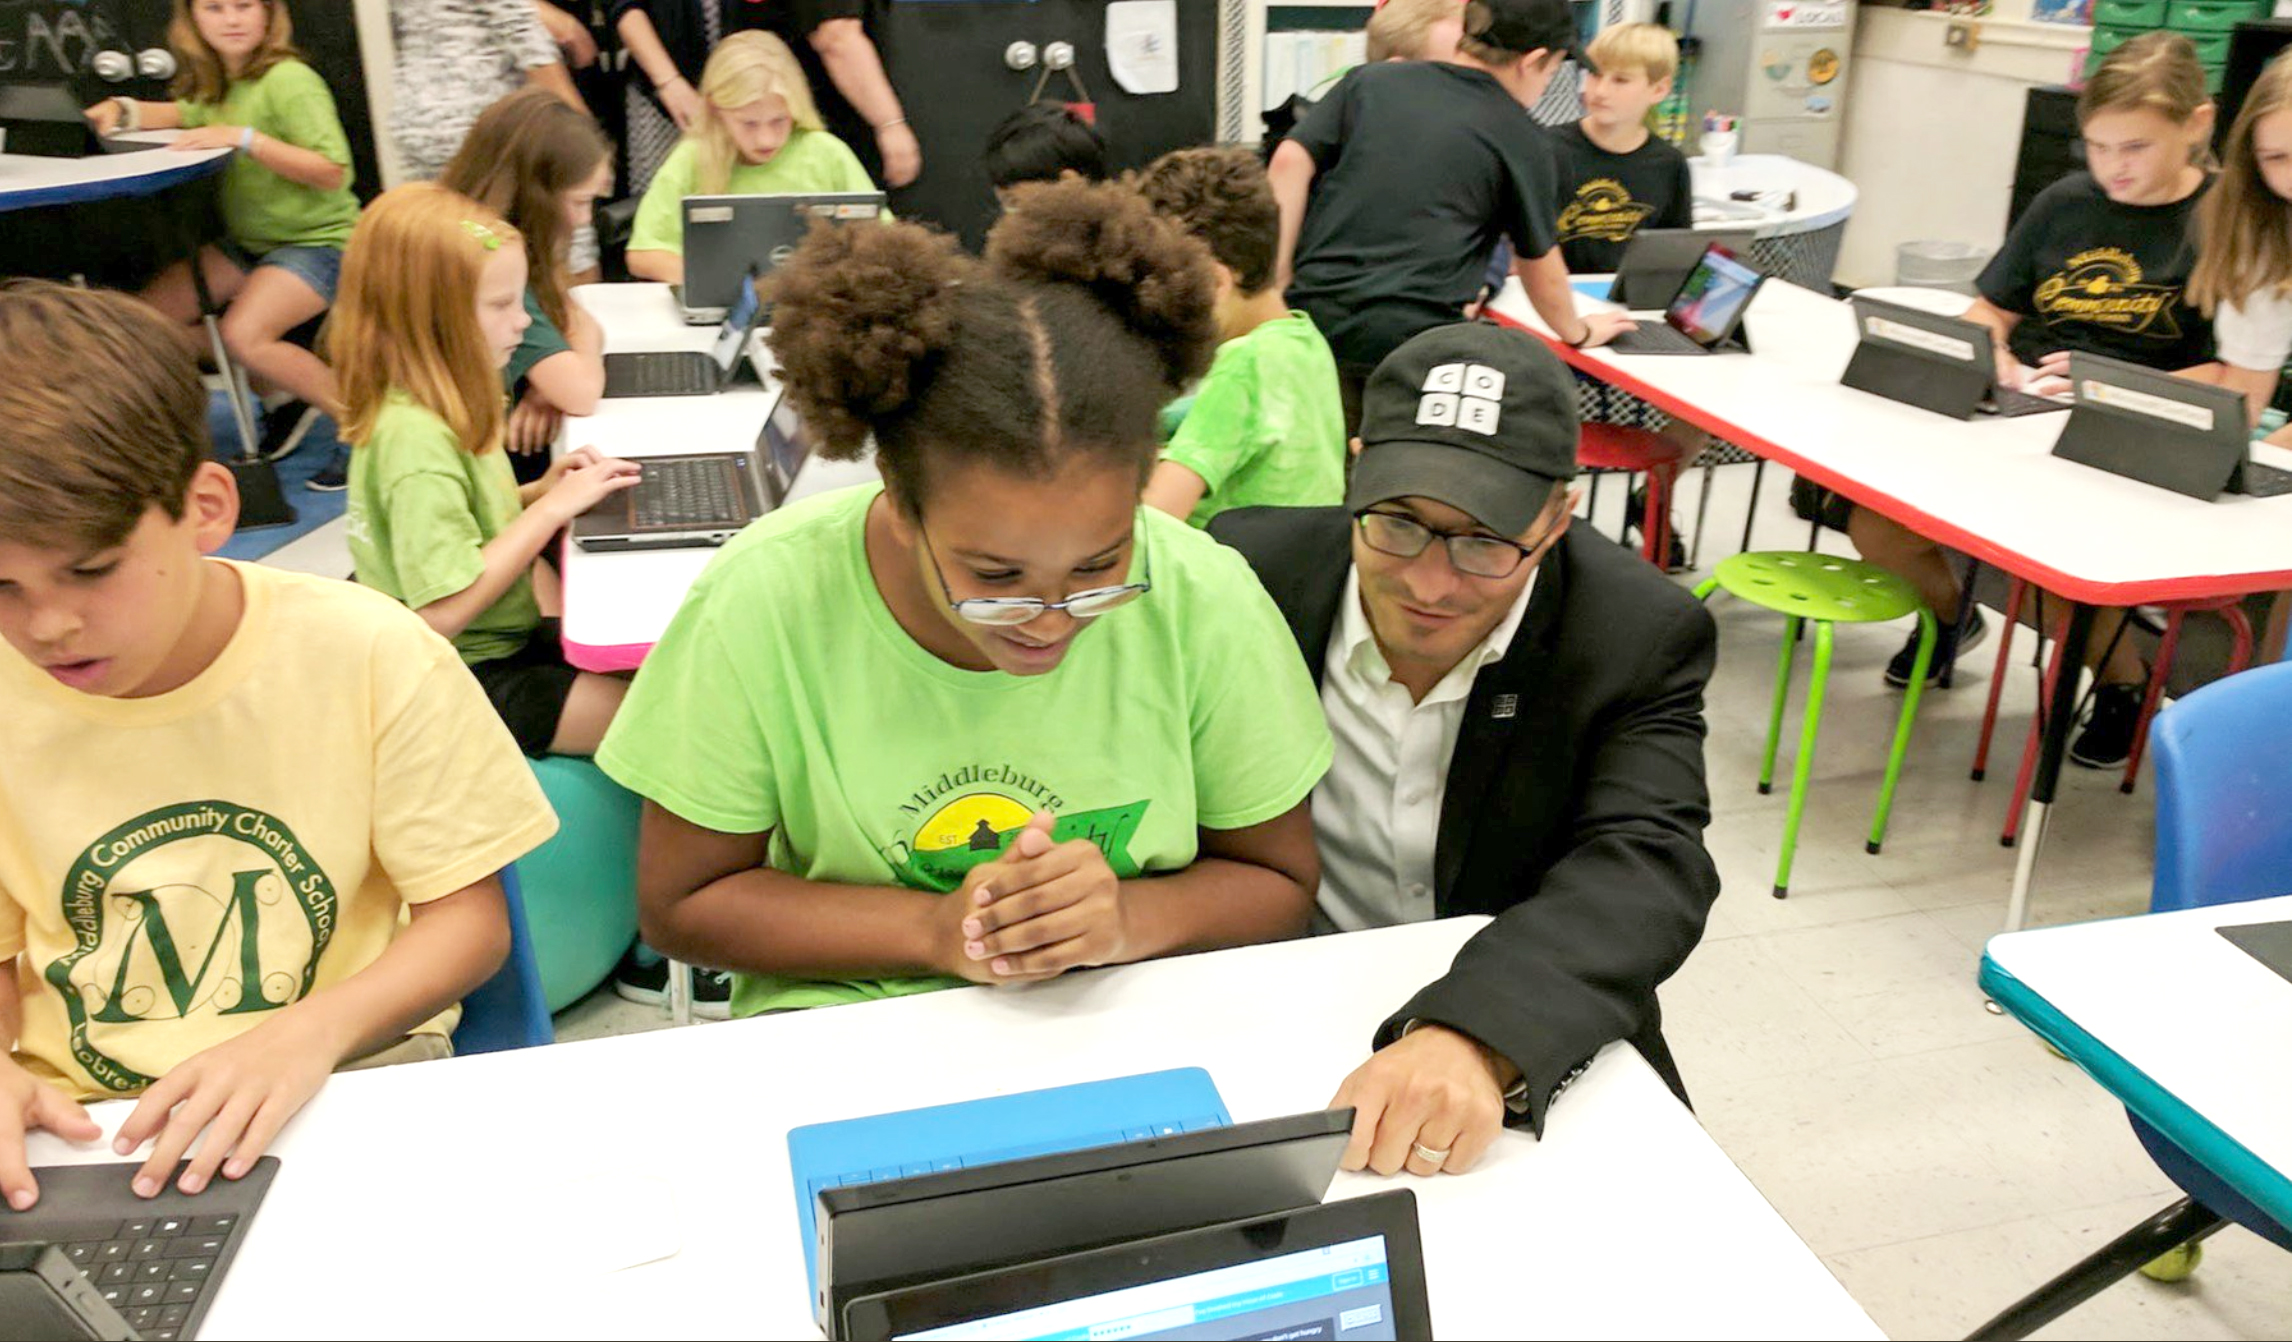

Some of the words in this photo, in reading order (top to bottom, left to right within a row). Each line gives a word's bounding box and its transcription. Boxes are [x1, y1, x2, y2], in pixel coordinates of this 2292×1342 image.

[899, 764, 1064, 818] Middleburg
[61, 870, 104, 966] Middleburg
[91, 806, 229, 867] Community
[234, 812, 304, 874] Charter
[299, 873, 334, 948] School
[90, 868, 289, 1023] M
